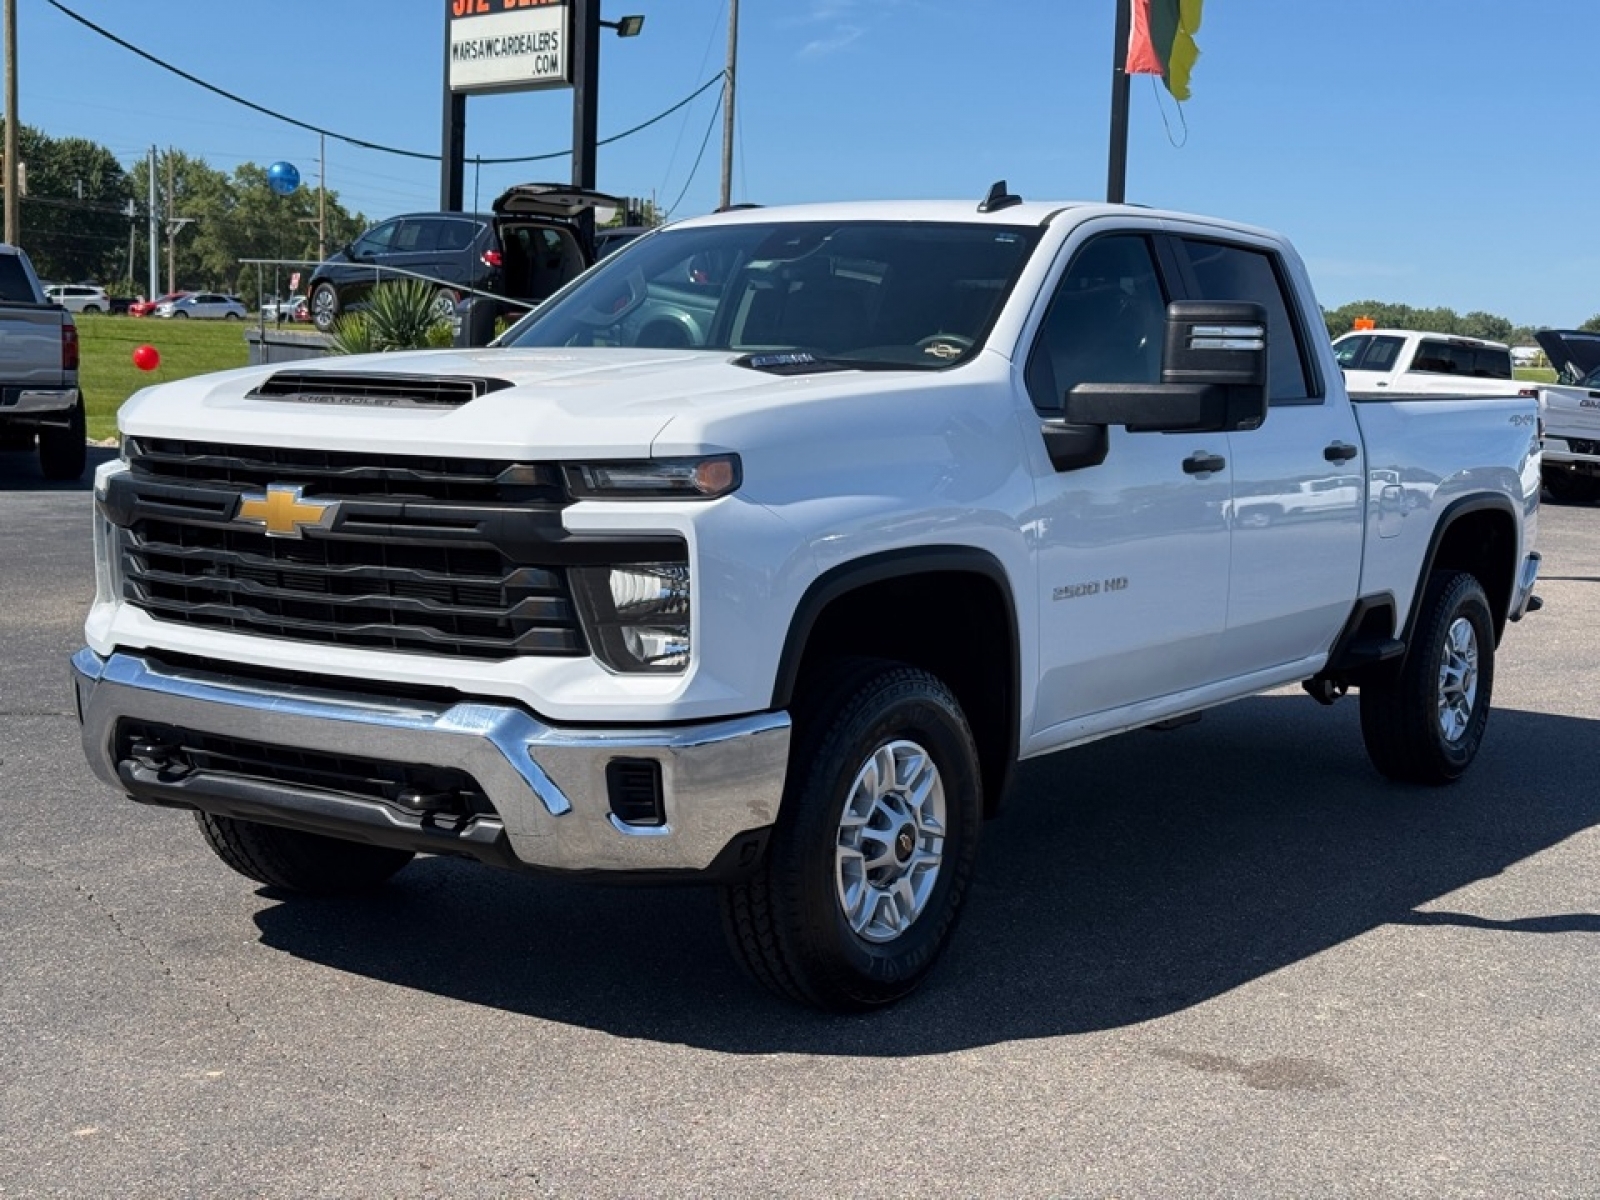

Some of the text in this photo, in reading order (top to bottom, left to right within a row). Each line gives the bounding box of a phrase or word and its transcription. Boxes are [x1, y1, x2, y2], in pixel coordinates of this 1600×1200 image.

[452, 31, 559, 61] WARSAWCARDEALERS
[533, 54, 559, 75] .COM
[1052, 577, 1129, 601] 2500 HD
